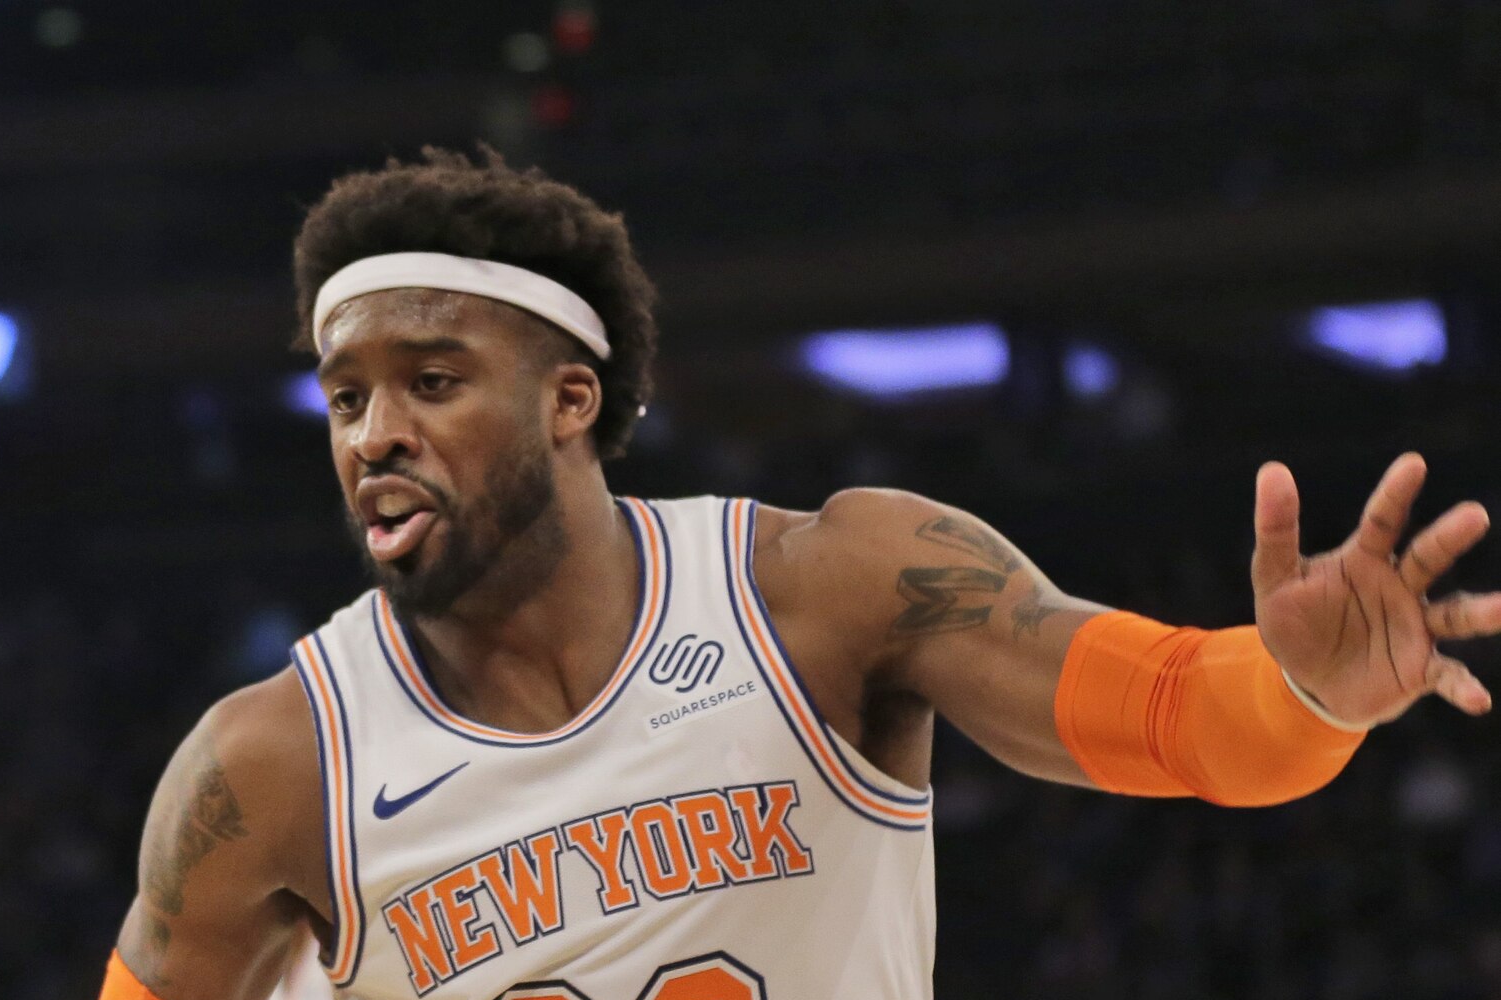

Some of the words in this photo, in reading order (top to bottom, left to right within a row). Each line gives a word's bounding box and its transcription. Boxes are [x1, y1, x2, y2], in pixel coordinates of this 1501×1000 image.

[649, 680, 757, 730] SQUARESPACE
[381, 826, 566, 998] NEW
[561, 780, 815, 915] YORK
